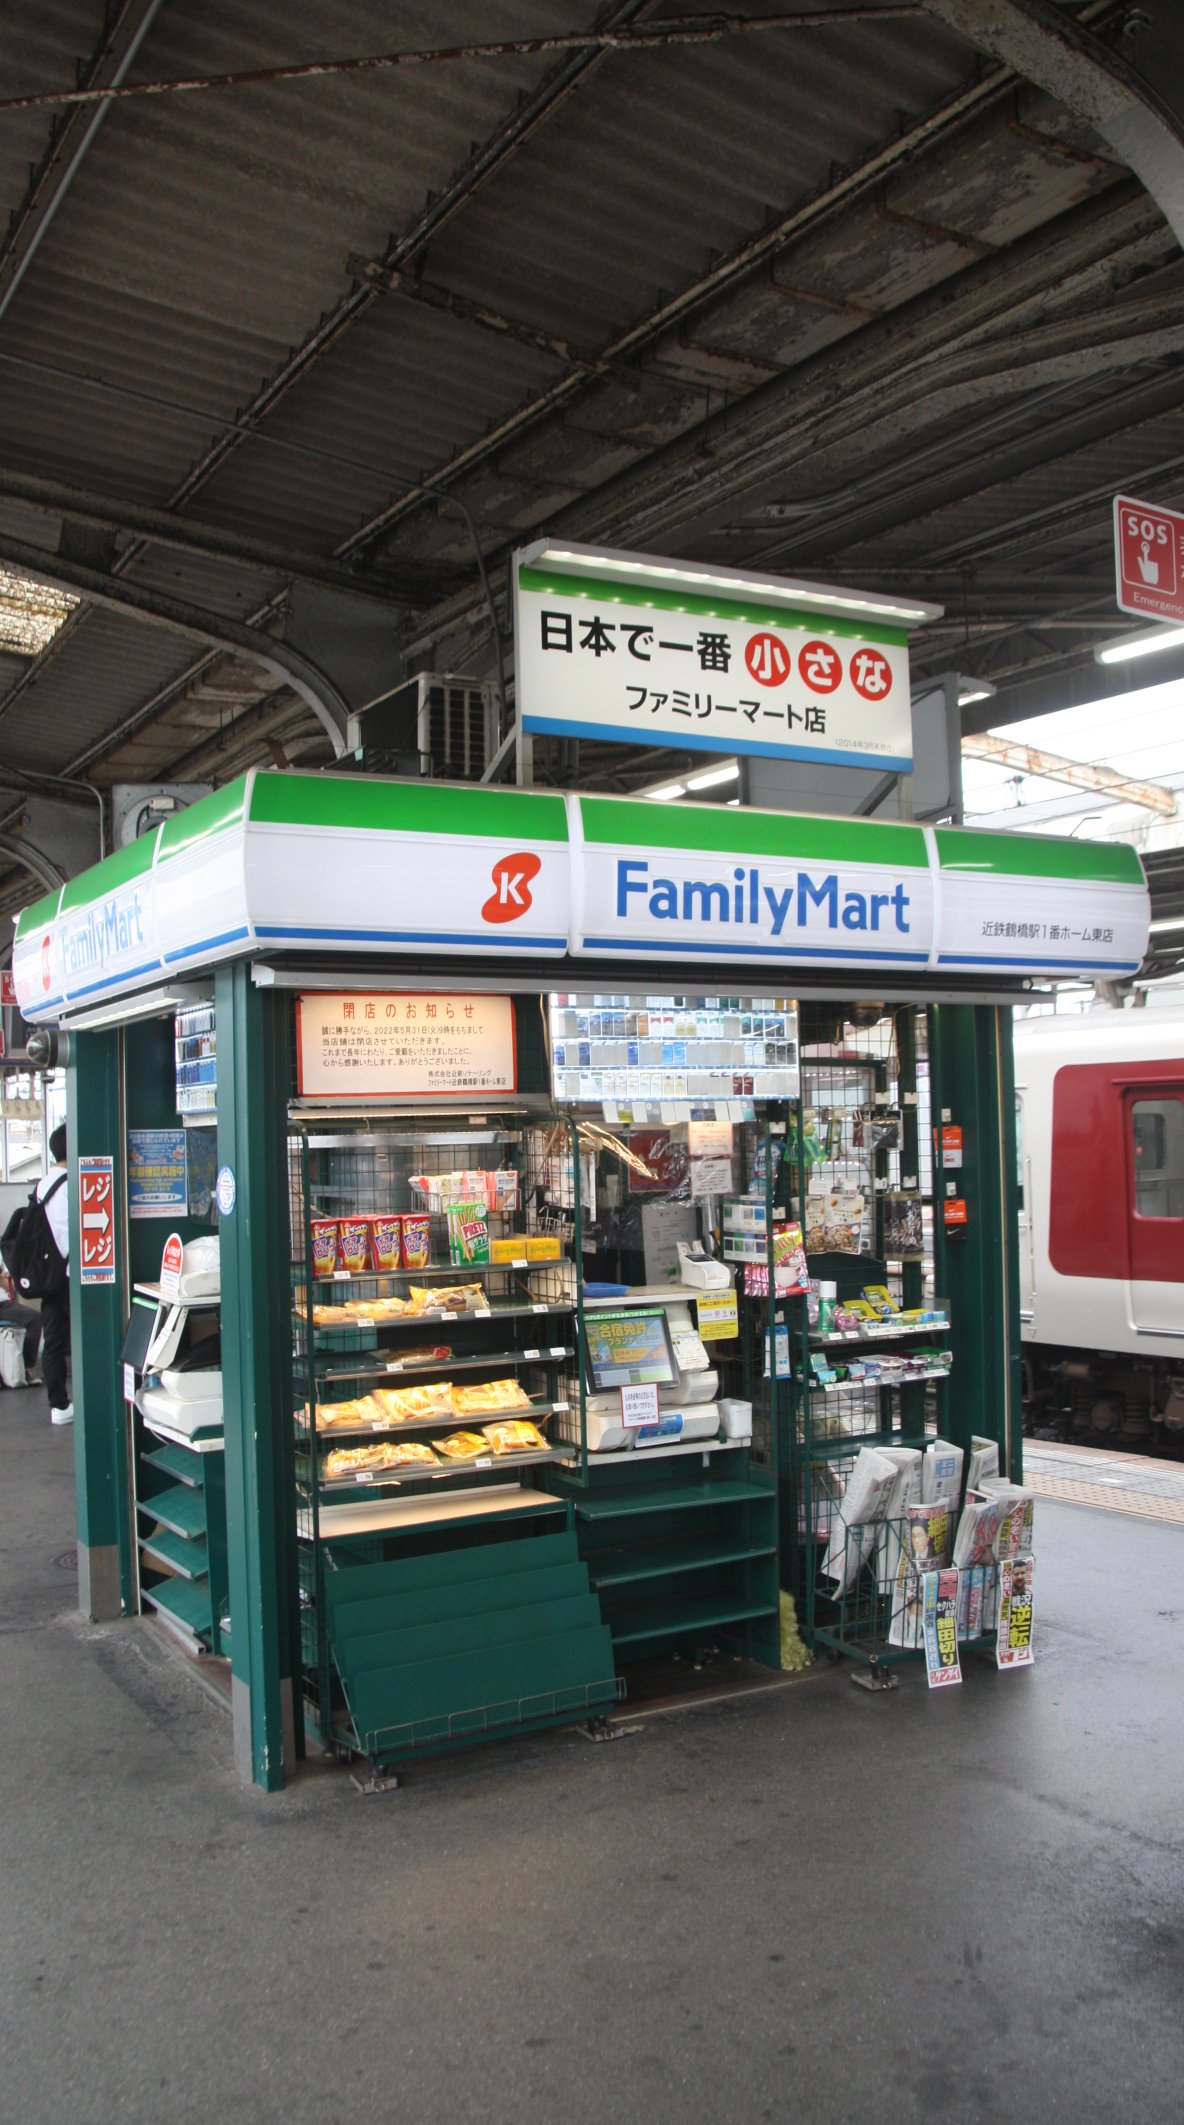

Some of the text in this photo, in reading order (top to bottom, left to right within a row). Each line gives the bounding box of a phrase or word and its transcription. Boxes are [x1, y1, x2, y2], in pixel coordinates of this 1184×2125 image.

[1127, 516, 1168, 545] SOS
[541, 610, 888, 692] 日本で一番小さな
[626, 685, 826, 734] ファミリーマート店
[616, 860, 910, 936] FamilyMart
[60, 894, 144, 976] FamilyMart
[981, 921, 1114, 943] 近鉄鶴橋駅1番ホーム東店
[343, 1002, 475, 1020] 閉店のお知らせ
[83, 1175, 111, 1202] レジ
[462, 1222, 486, 1239] PRETZ
[84, 1236, 112, 1263] レジ
[937, 1600, 956, 1612] セクハラ
[937, 1616, 956, 1666] 細田切り
[1009, 1605, 1031, 1648] 逆転
